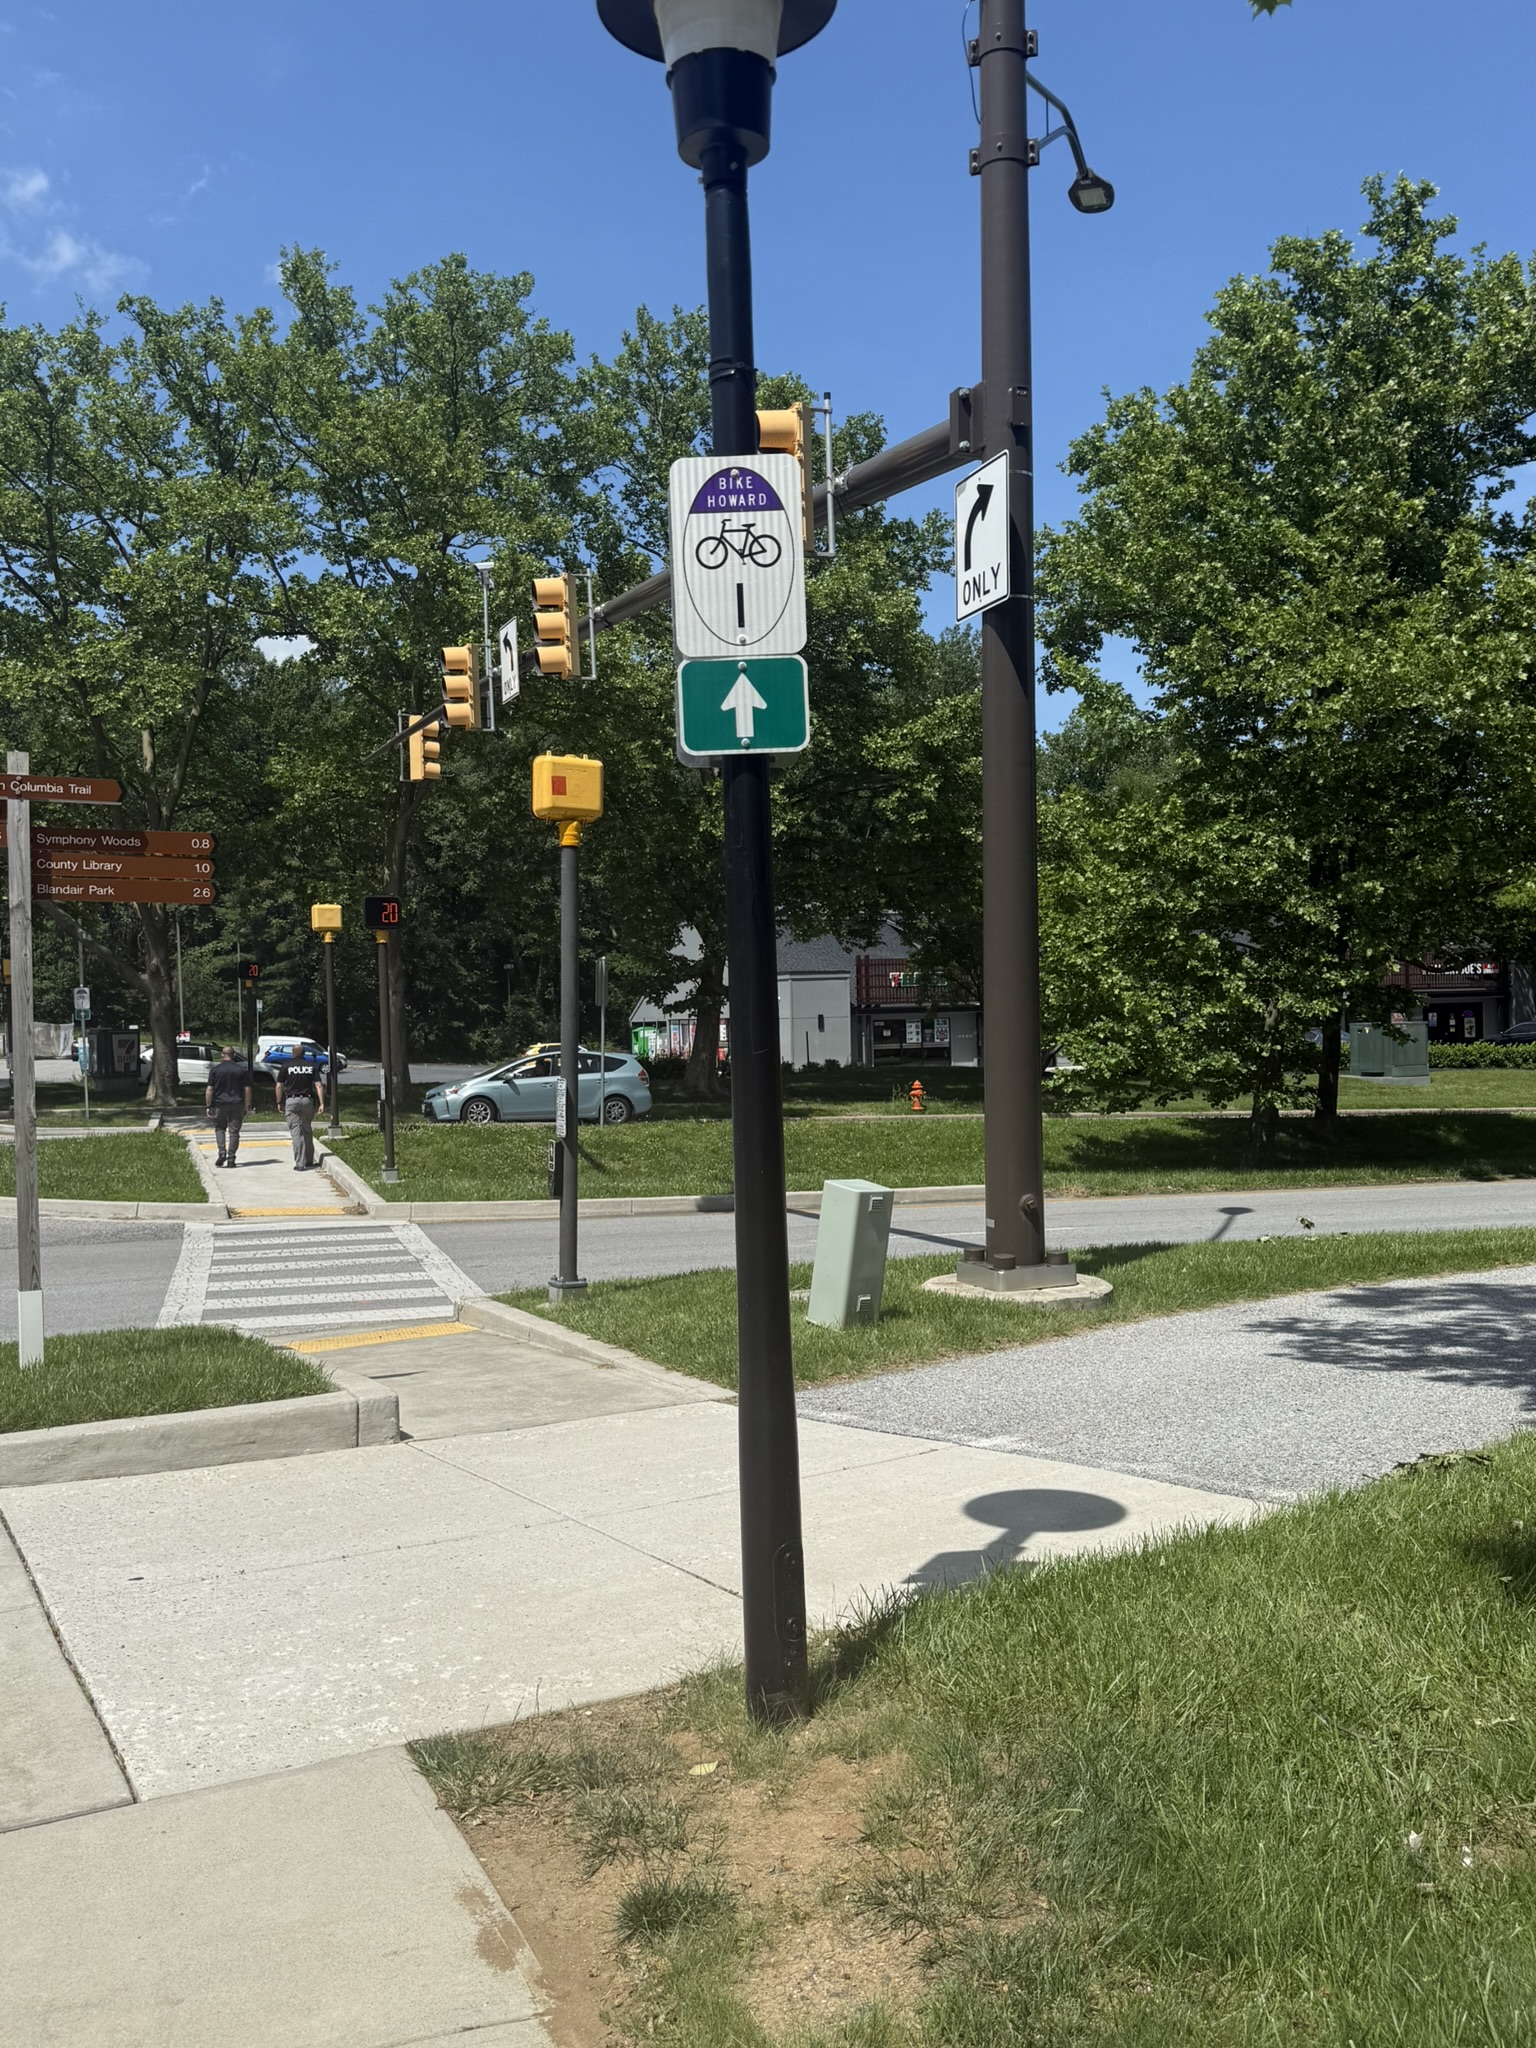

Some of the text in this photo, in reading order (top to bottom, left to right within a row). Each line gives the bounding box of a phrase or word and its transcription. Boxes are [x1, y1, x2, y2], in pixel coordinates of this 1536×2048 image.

[719, 476, 753, 490] BIKE
[707, 493, 767, 508] HOWARD
[963, 562, 1001, 606] ONLY
[10, 780, 64, 794] Columbia
[68, 783, 92, 795] Trail
[36, 834, 210, 849] Symphony Woods 0.8
[37, 859, 210, 873] County Library 1.0
[37, 884, 210, 897] Blandair Park 2.6
[382, 902, 398, 923] 20
[249, 964, 259, 977] 20
[288, 1065, 313, 1075] POLICE
